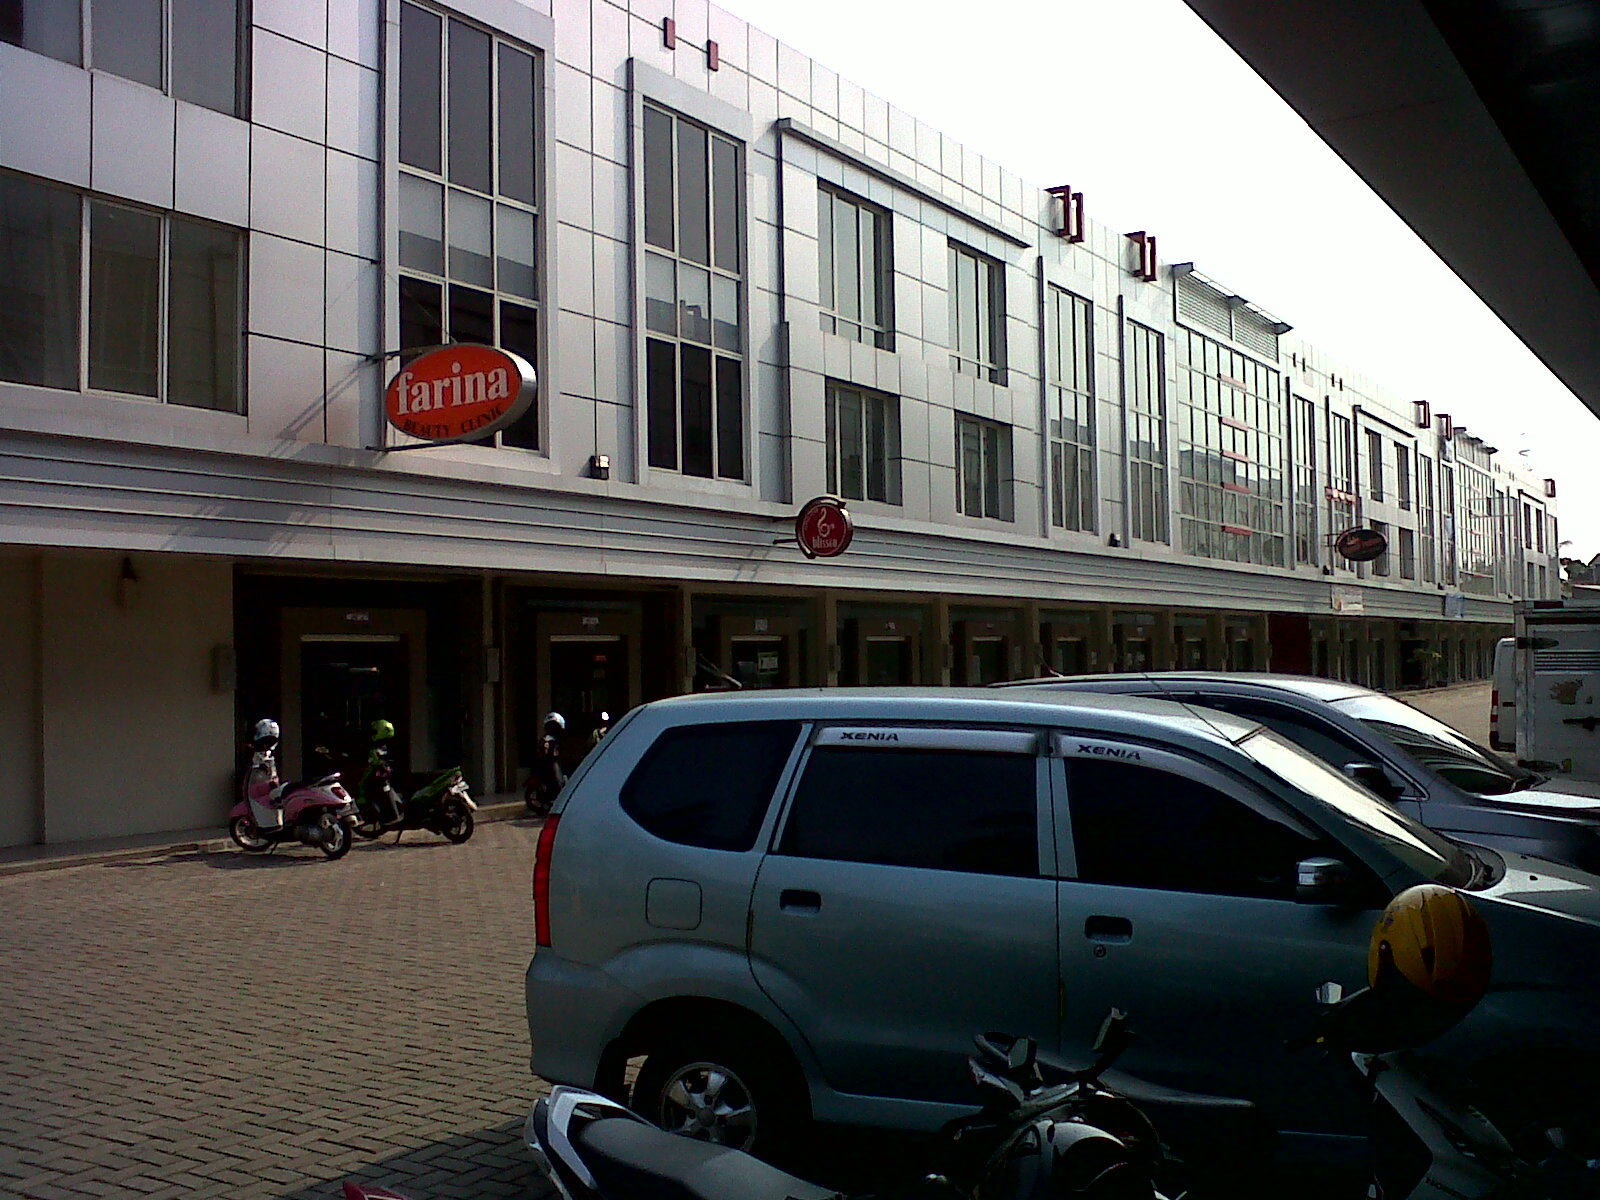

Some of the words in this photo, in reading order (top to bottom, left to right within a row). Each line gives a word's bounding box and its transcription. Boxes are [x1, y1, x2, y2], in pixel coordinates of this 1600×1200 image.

[396, 361, 510, 416] farina
[841, 732, 899, 741] XENIA
[1077, 744, 1141, 760] XENIA
